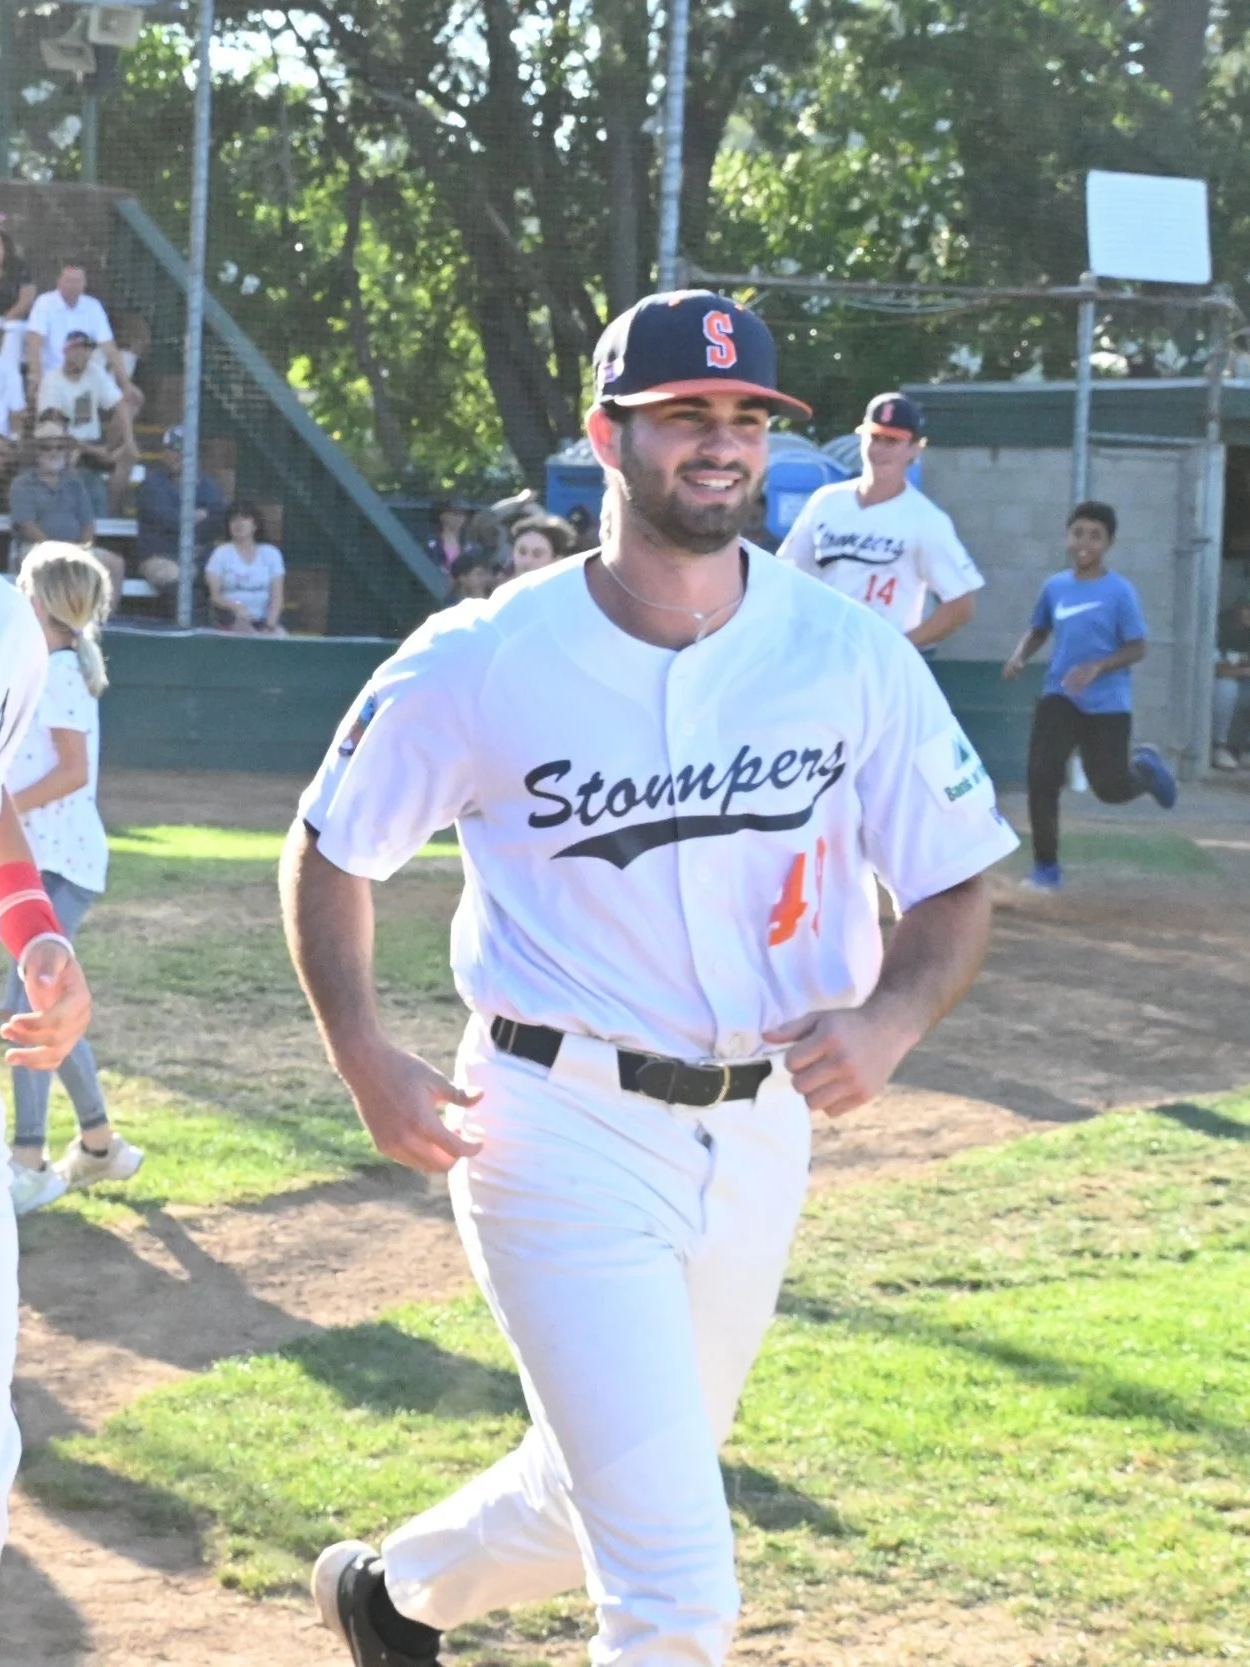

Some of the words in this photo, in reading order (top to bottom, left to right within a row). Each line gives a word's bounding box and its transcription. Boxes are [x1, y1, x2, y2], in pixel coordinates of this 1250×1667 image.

[703, 310, 738, 369] S
[864, 574, 897, 606] 14
[524, 740, 847, 829] Stompers
